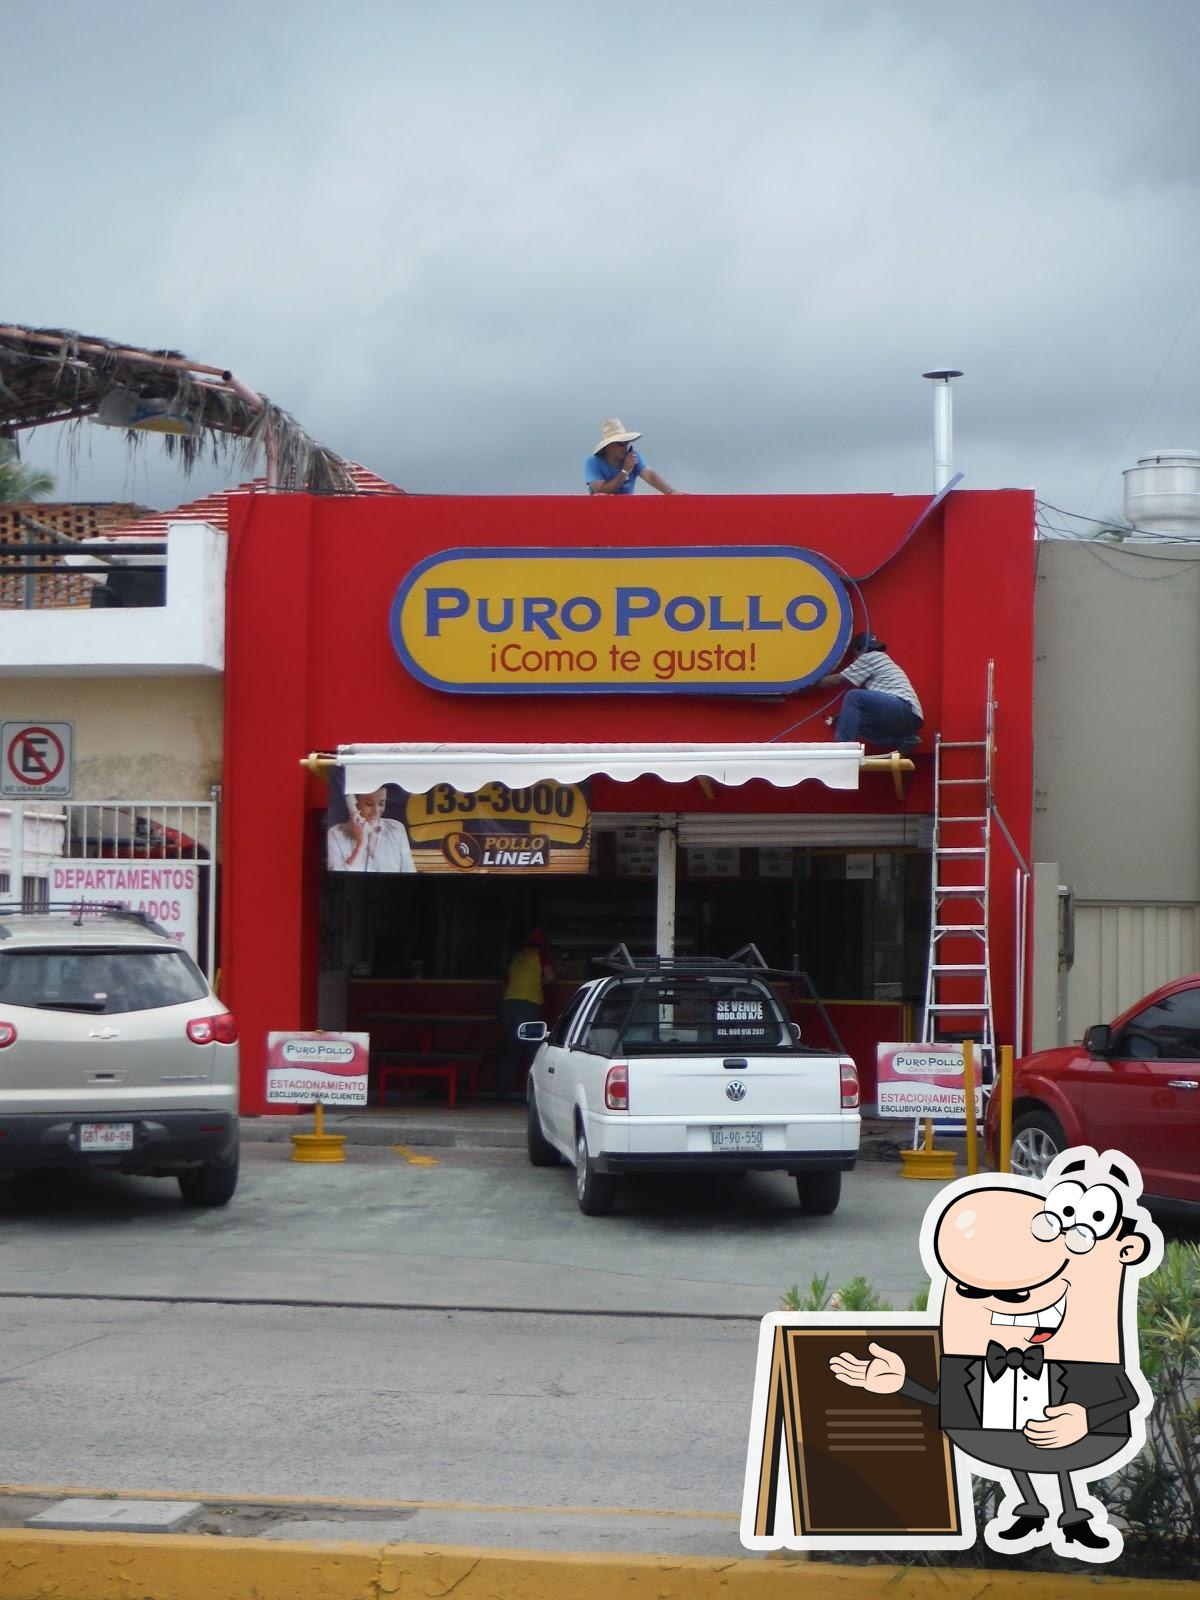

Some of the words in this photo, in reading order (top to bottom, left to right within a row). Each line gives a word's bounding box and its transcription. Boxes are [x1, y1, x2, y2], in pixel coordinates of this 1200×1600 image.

[424, 587, 602, 640] PURO
[614, 586, 828, 636] POLLO
[491, 643, 598, 672] ¡Como
[609, 644, 641, 672] te
[653, 643, 756, 679] gusta!
[484, 837, 545, 850] POLLO
[482, 851, 545, 865] LÍNEA
[54, 868, 194, 889] DEPARTAMENTOS
[717, 1001, 730, 1011] SE
[731, 1001, 763, 1012] VENDE
[748, 1012, 763, 1020] A/C
[287, 1045, 315, 1055] PURO
[318, 1045, 352, 1055] POLLO
[897, 1057, 926, 1066] PURO
[929, 1057, 964, 1066] POLLO
[270, 1080, 366, 1091] ESTACIONAMIENTO
[881, 1093, 979, 1103] ESTACIONAMIENO
[923, 1105, 942, 1113] PARA
